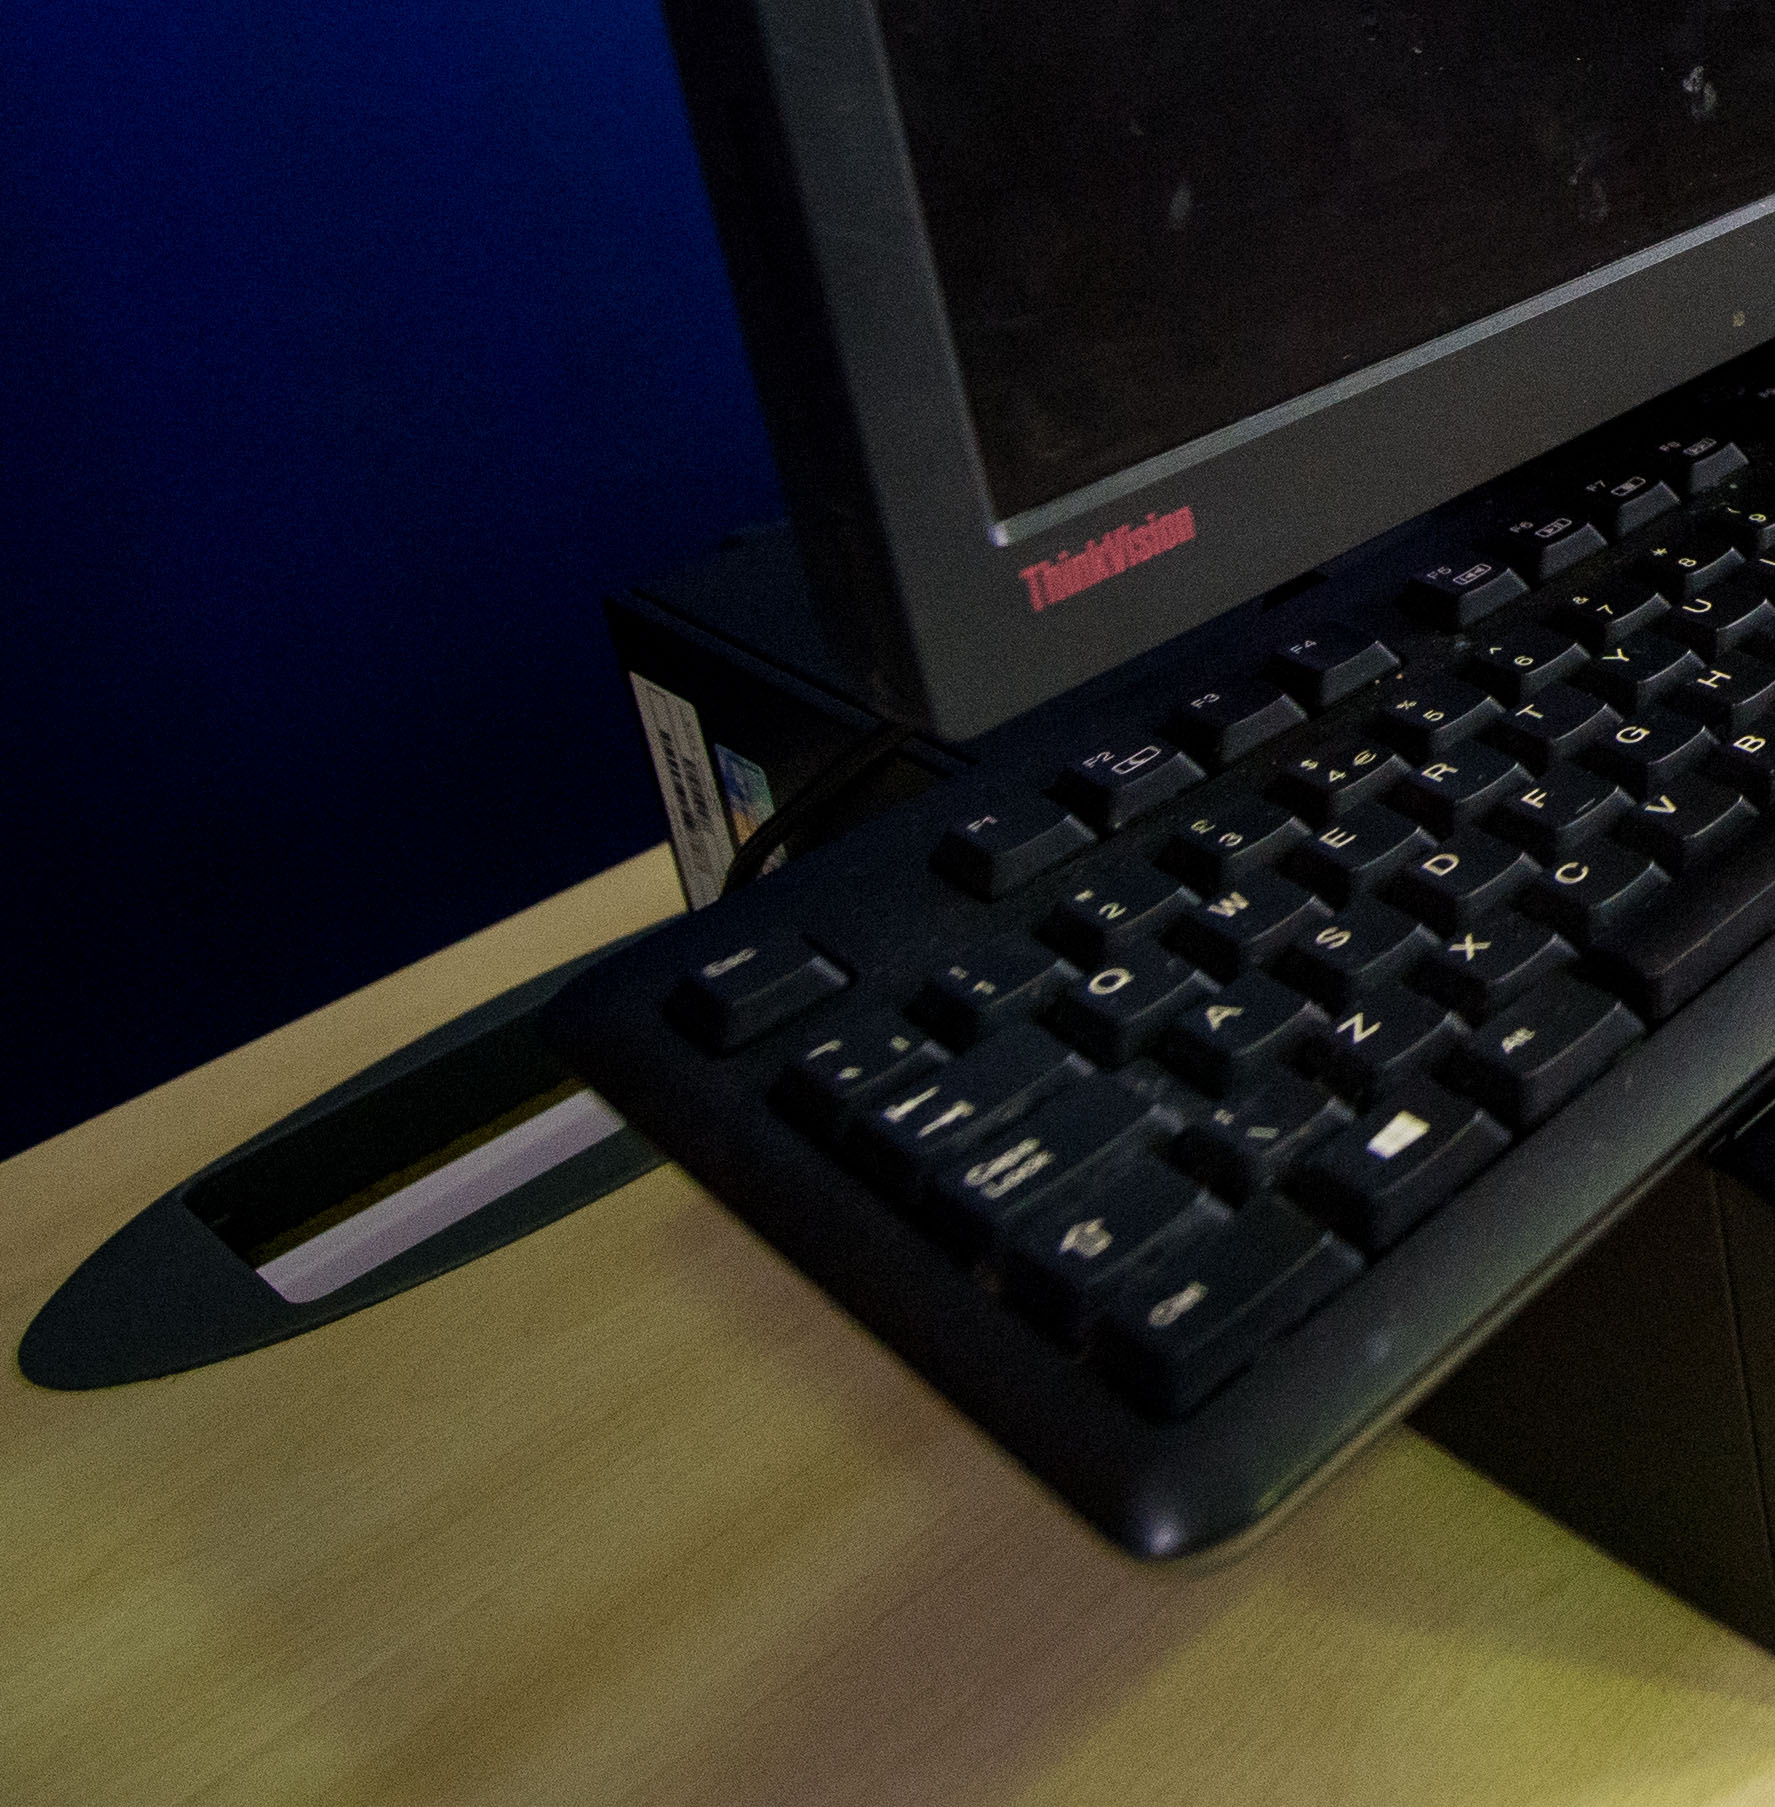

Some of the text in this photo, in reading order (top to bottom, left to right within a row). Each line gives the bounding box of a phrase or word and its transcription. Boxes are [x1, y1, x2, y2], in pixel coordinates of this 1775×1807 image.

[1748, 513, 1767, 523] 9
[1019, 505, 1196, 612] ThinkVision
[1677, 557, 1697, 568] 8
[1596, 603, 1614, 615] 7
[1682, 598, 1713, 614] U
[1513, 655, 1534, 667] 6
[1602, 648, 1630, 662] Y
[1697, 669, 1732, 689] H
[1422, 710, 1445, 722] 5
[1515, 703, 1543, 719] T
[1615, 726, 1650, 744] G
[1733, 735, 1766, 753] B
[1328, 750, 1377, 783] 4 €
[1421, 763, 1458, 782] R
[1521, 788, 1547, 809] F
[1645, 795, 1677, 814] V
[1218, 832, 1243, 847] 3
[1319, 827, 1356, 849] E
[1421, 853, 1459, 877] D
[1554, 862, 1589, 884] C
[1098, 903, 1126, 920] 2
[1208, 892, 1248, 917] W
[1315, 927, 1351, 950] S
[1449, 934, 1490, 961] X
[1088, 968, 1132, 995] Q
[1205, 1006, 1242, 1030] A
[1336, 1013, 1380, 1044] Z
